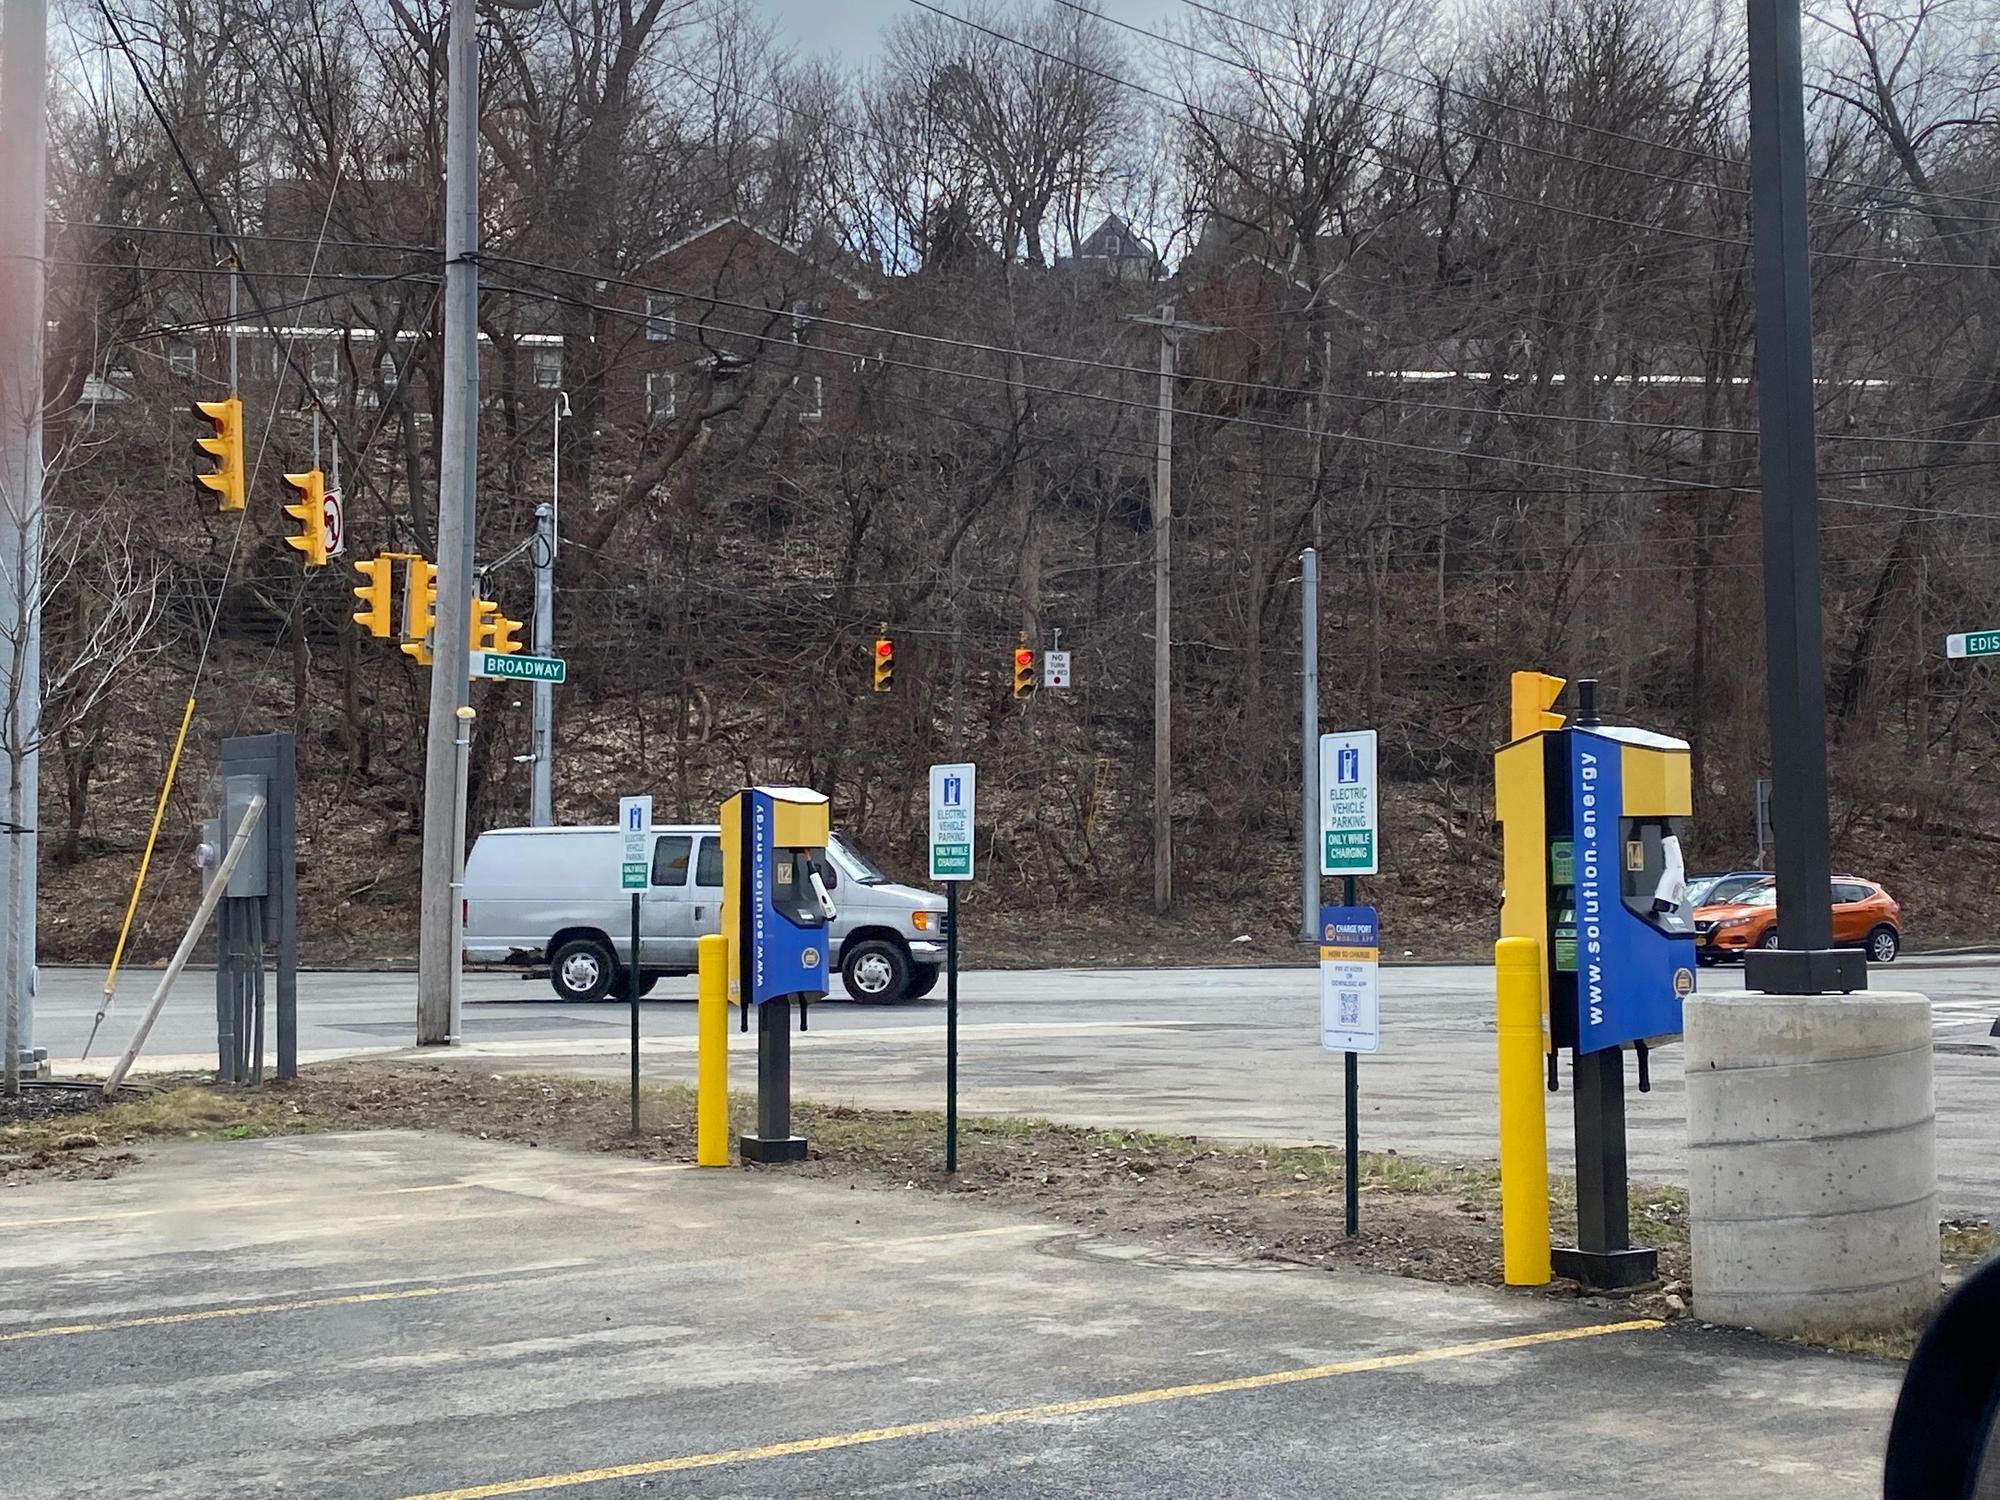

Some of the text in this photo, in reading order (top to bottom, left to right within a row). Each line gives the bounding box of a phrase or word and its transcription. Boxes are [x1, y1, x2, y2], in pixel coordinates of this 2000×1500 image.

[1970, 636, 2000, 651] EDIS
[487, 658, 560, 677] BROADWAY
[1330, 787, 1367, 800] ELECTRIC
[1332, 801, 1365, 814] VEHICLE
[937, 809, 967, 819] ELECTRIC
[939, 820, 965, 831] VEHICLE
[1332, 815, 1366, 828] PARKING
[938, 832, 965, 842] PARKING
[1328, 833, 1370, 845] ONLY WHILE
[936, 846, 968, 856] ONLY WHILE
[1331, 847, 1367, 859] CHARGING
[937, 857, 966, 867] CHARGING
[780, 866, 791, 881] 12
[1580, 752, 1603, 1026] www.solution.energy
[756, 804, 764, 988] www.solution.energy
[1336, 924, 1372, 934] CHARGE PORT
[1336, 934, 1360, 942] MOBILE
[1349, 951, 1370, 959] CHARGE
